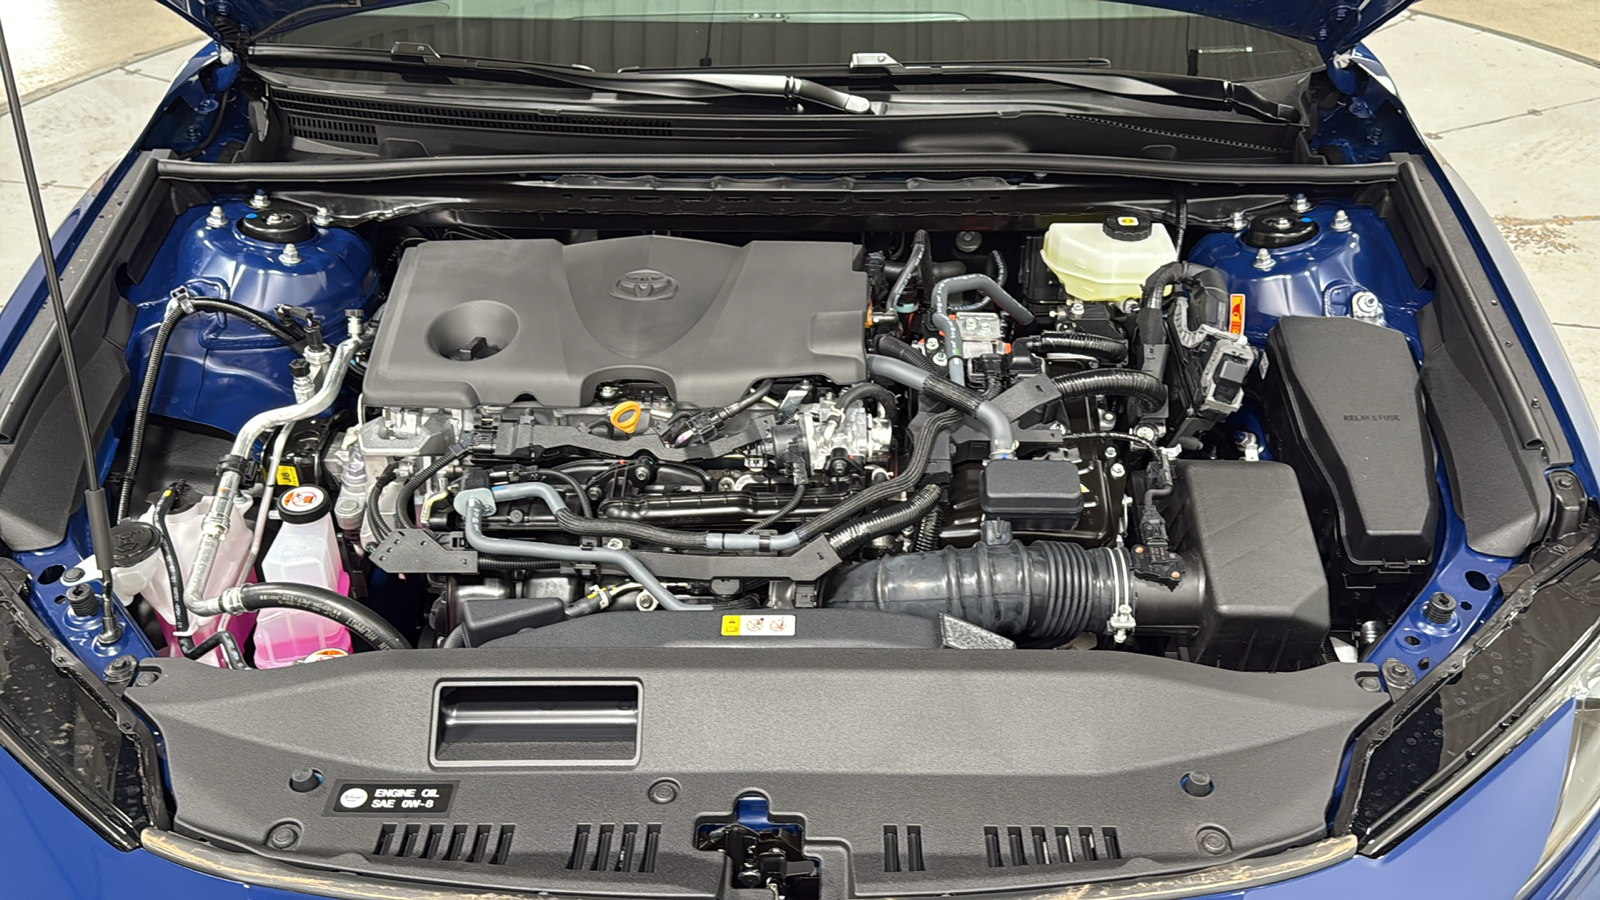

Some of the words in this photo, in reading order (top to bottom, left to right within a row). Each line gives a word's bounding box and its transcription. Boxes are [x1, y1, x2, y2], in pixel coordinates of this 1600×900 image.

[374, 788, 417, 798] ENGINE
[421, 788, 440, 798] OIL
[371, 799, 396, 808] SAE
